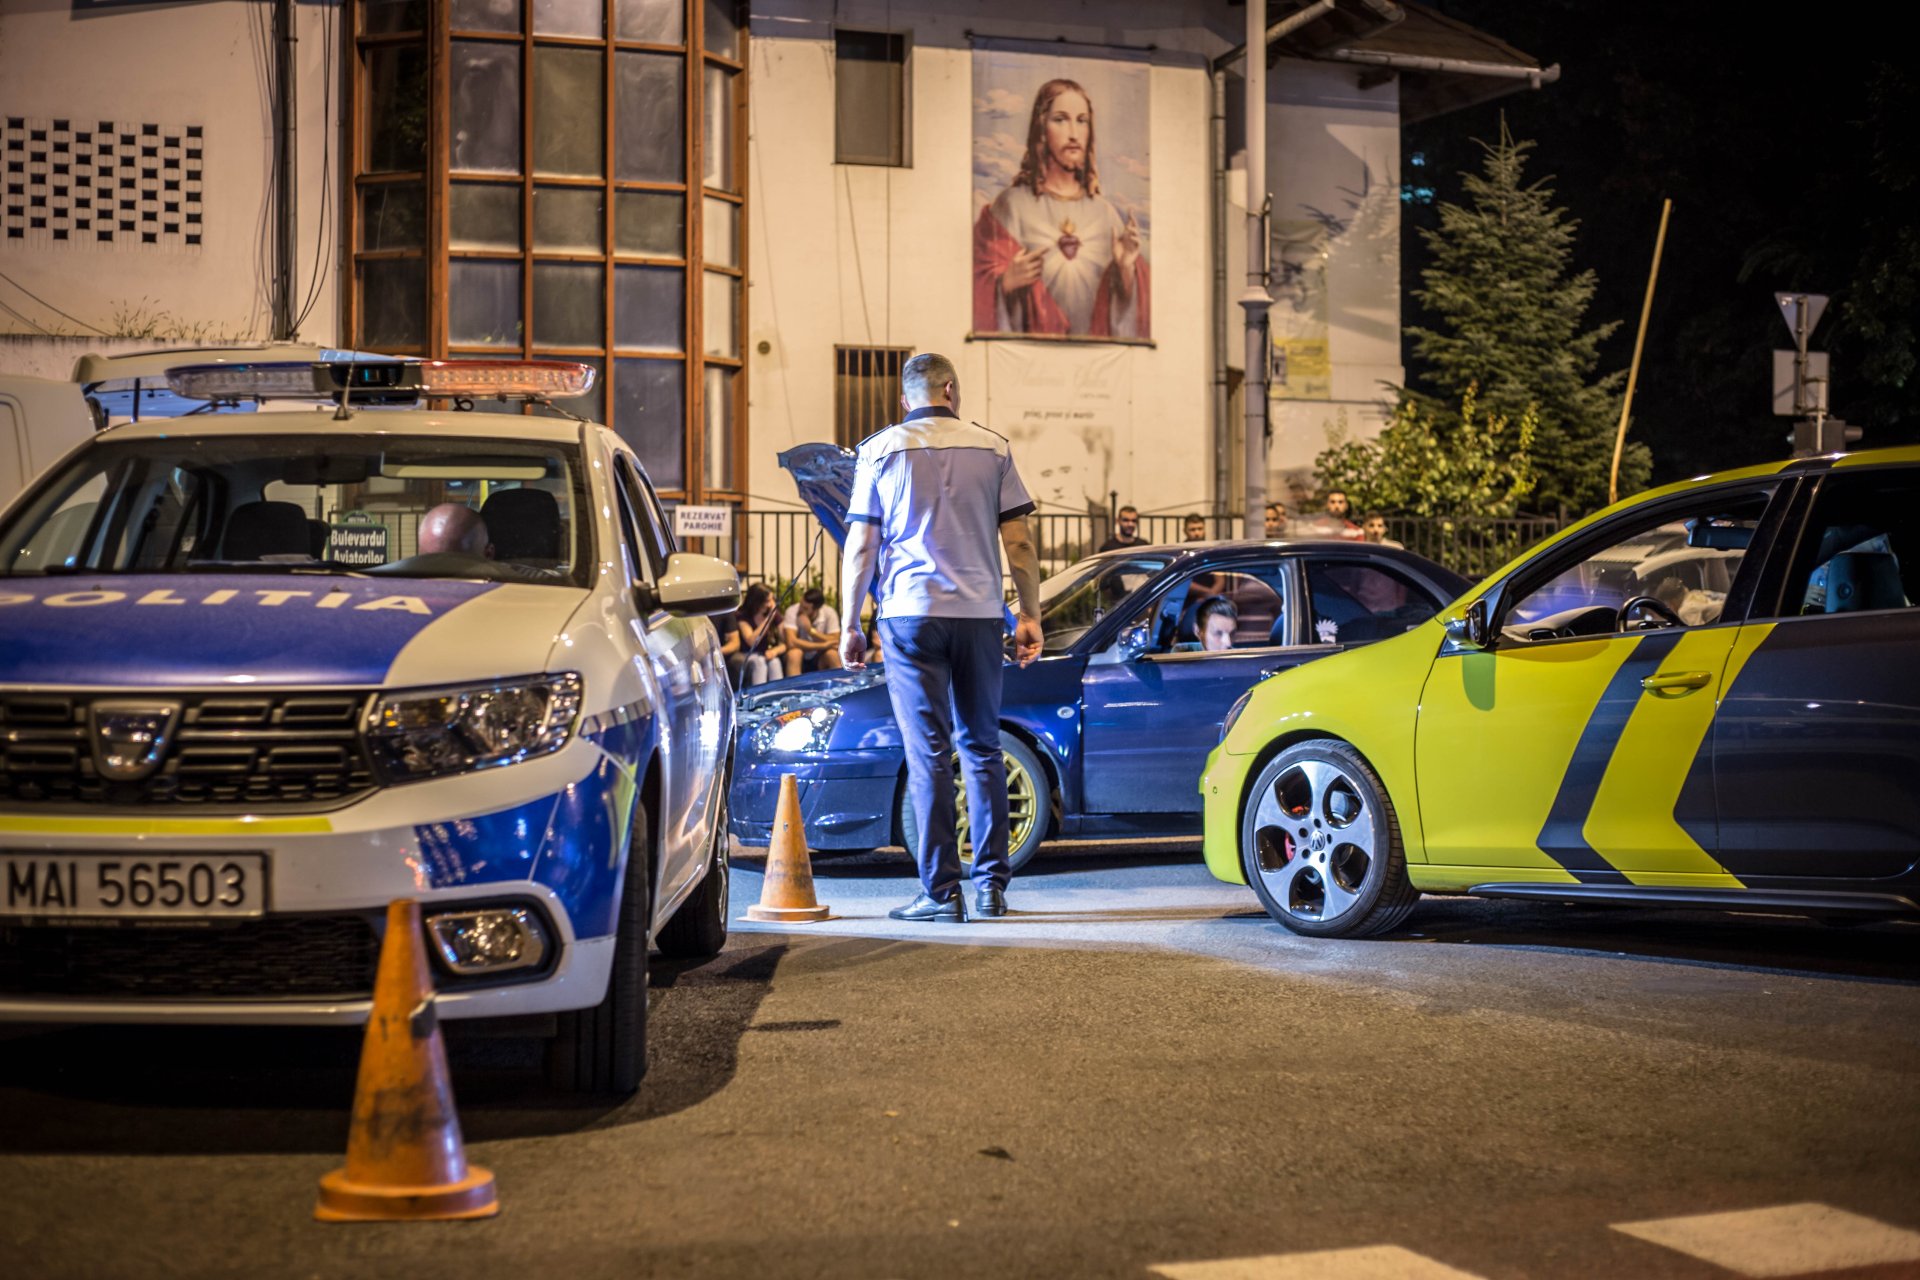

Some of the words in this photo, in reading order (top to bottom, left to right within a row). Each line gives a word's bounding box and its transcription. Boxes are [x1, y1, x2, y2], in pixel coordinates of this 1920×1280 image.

[680, 511, 726, 520] REZERVAT
[684, 522, 722, 530] PAROHIE
[331, 530, 386, 547] Bulevardul
[334, 550, 385, 564] Aviatorilor
[7, 861, 78, 908] MAI
[98, 861, 245, 908] 56503
